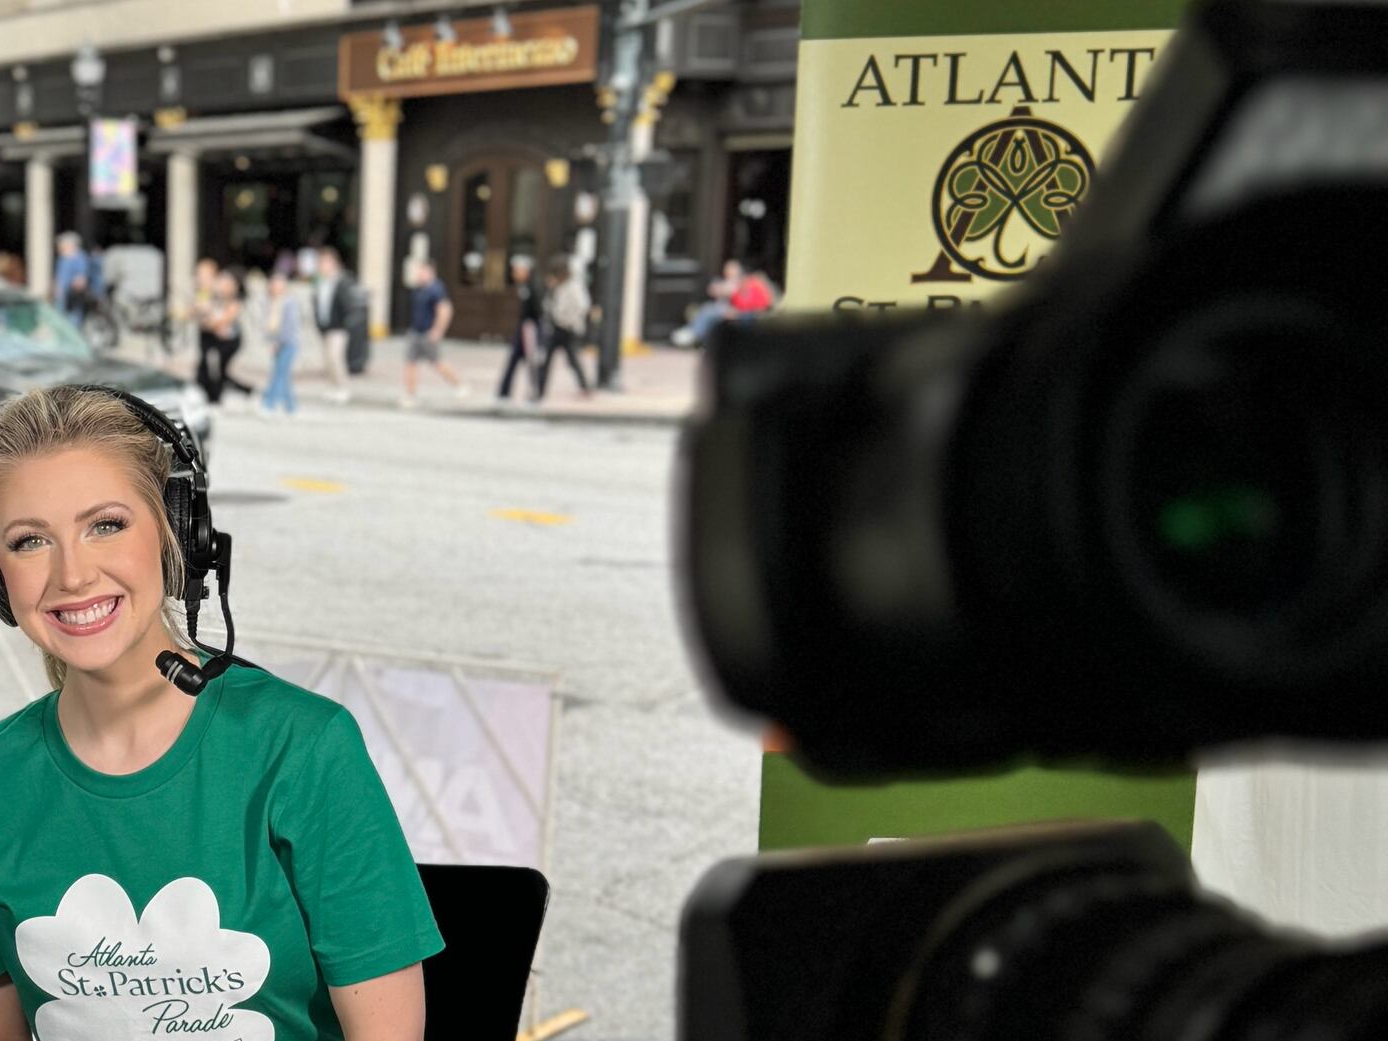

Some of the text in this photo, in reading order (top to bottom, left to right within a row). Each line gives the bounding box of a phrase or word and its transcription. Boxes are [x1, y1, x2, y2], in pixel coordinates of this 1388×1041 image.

[841, 47, 1155, 107] ATLANT
[67, 937, 158, 968] Atlanta
[108, 967, 245, 997] Patrick's
[142, 999, 234, 1035] Parade
